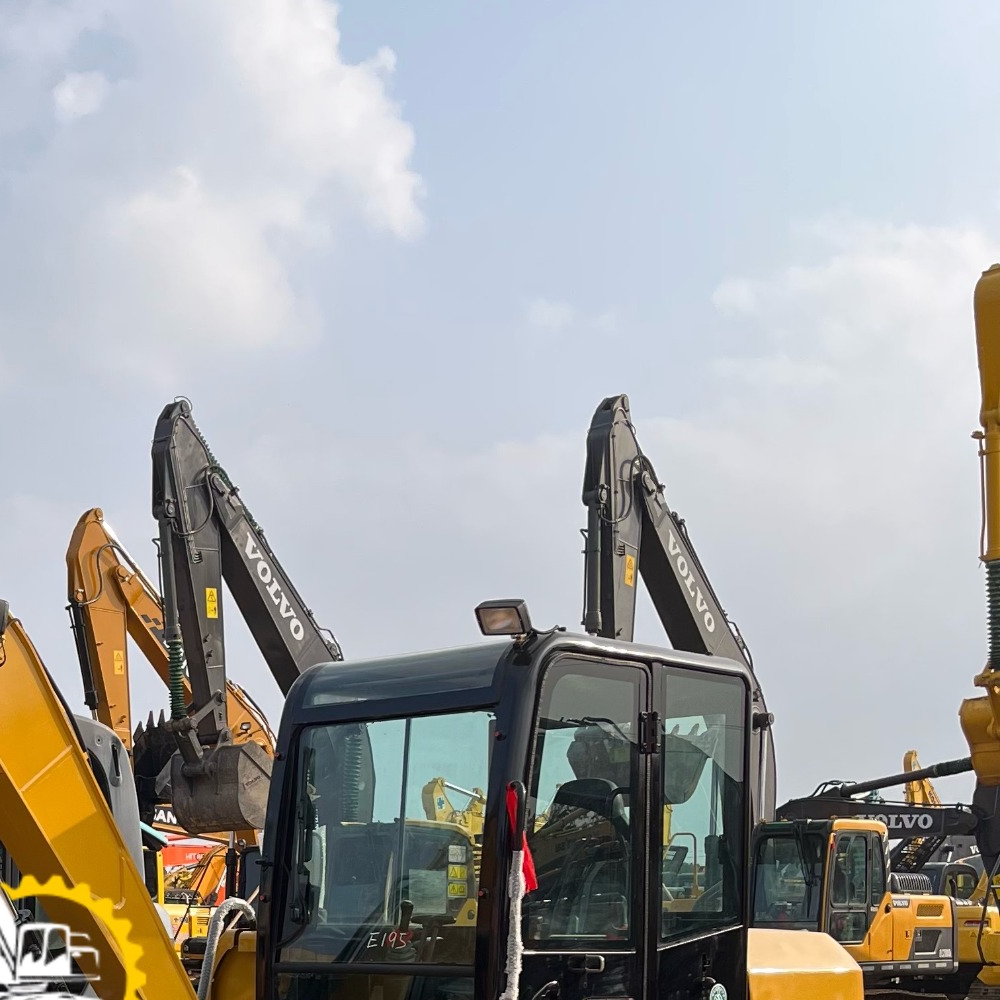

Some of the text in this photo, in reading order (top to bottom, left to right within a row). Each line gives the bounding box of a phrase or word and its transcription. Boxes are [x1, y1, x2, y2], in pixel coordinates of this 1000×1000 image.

[245, 532, 304, 641] VOLVO
[668, 529, 715, 633] VOLVO
[366, 931, 407, 949] E195
